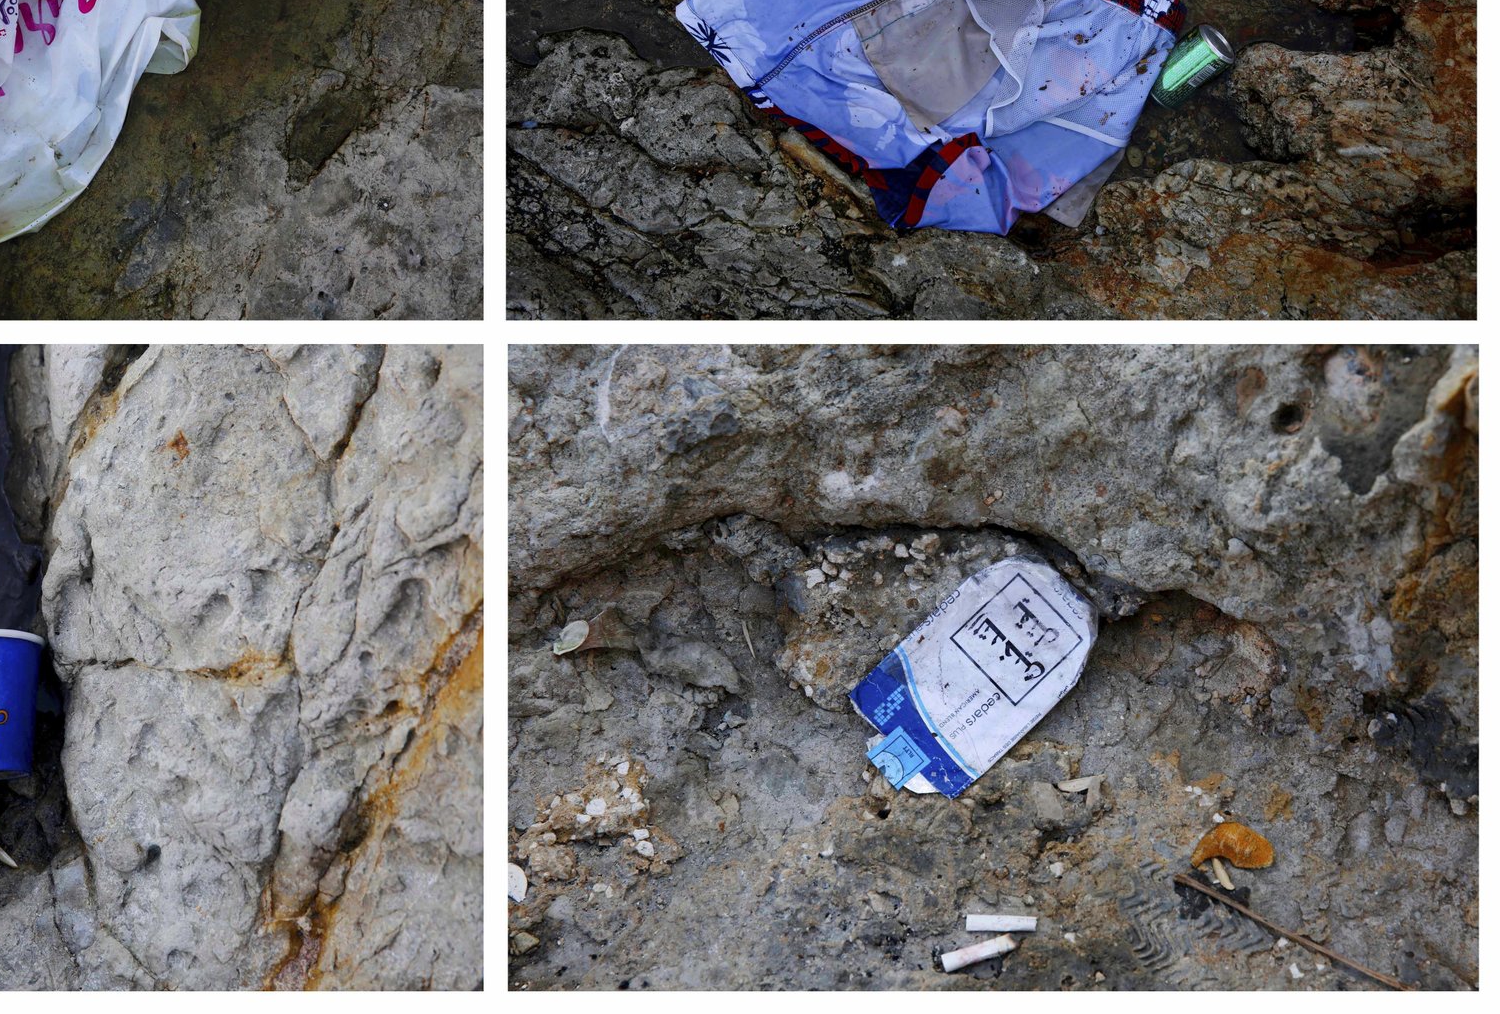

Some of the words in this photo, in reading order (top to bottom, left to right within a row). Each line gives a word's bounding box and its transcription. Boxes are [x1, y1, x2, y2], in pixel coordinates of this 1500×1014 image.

[1012, 597, 1060, 647] يقتل
[968, 612, 1045, 682] التدخين
[954, 688, 980, 714] AMERICAN
[966, 692, 1001, 726] cedars
[938, 713, 955, 729] BLEND
[949, 723, 966, 740] PLUS
